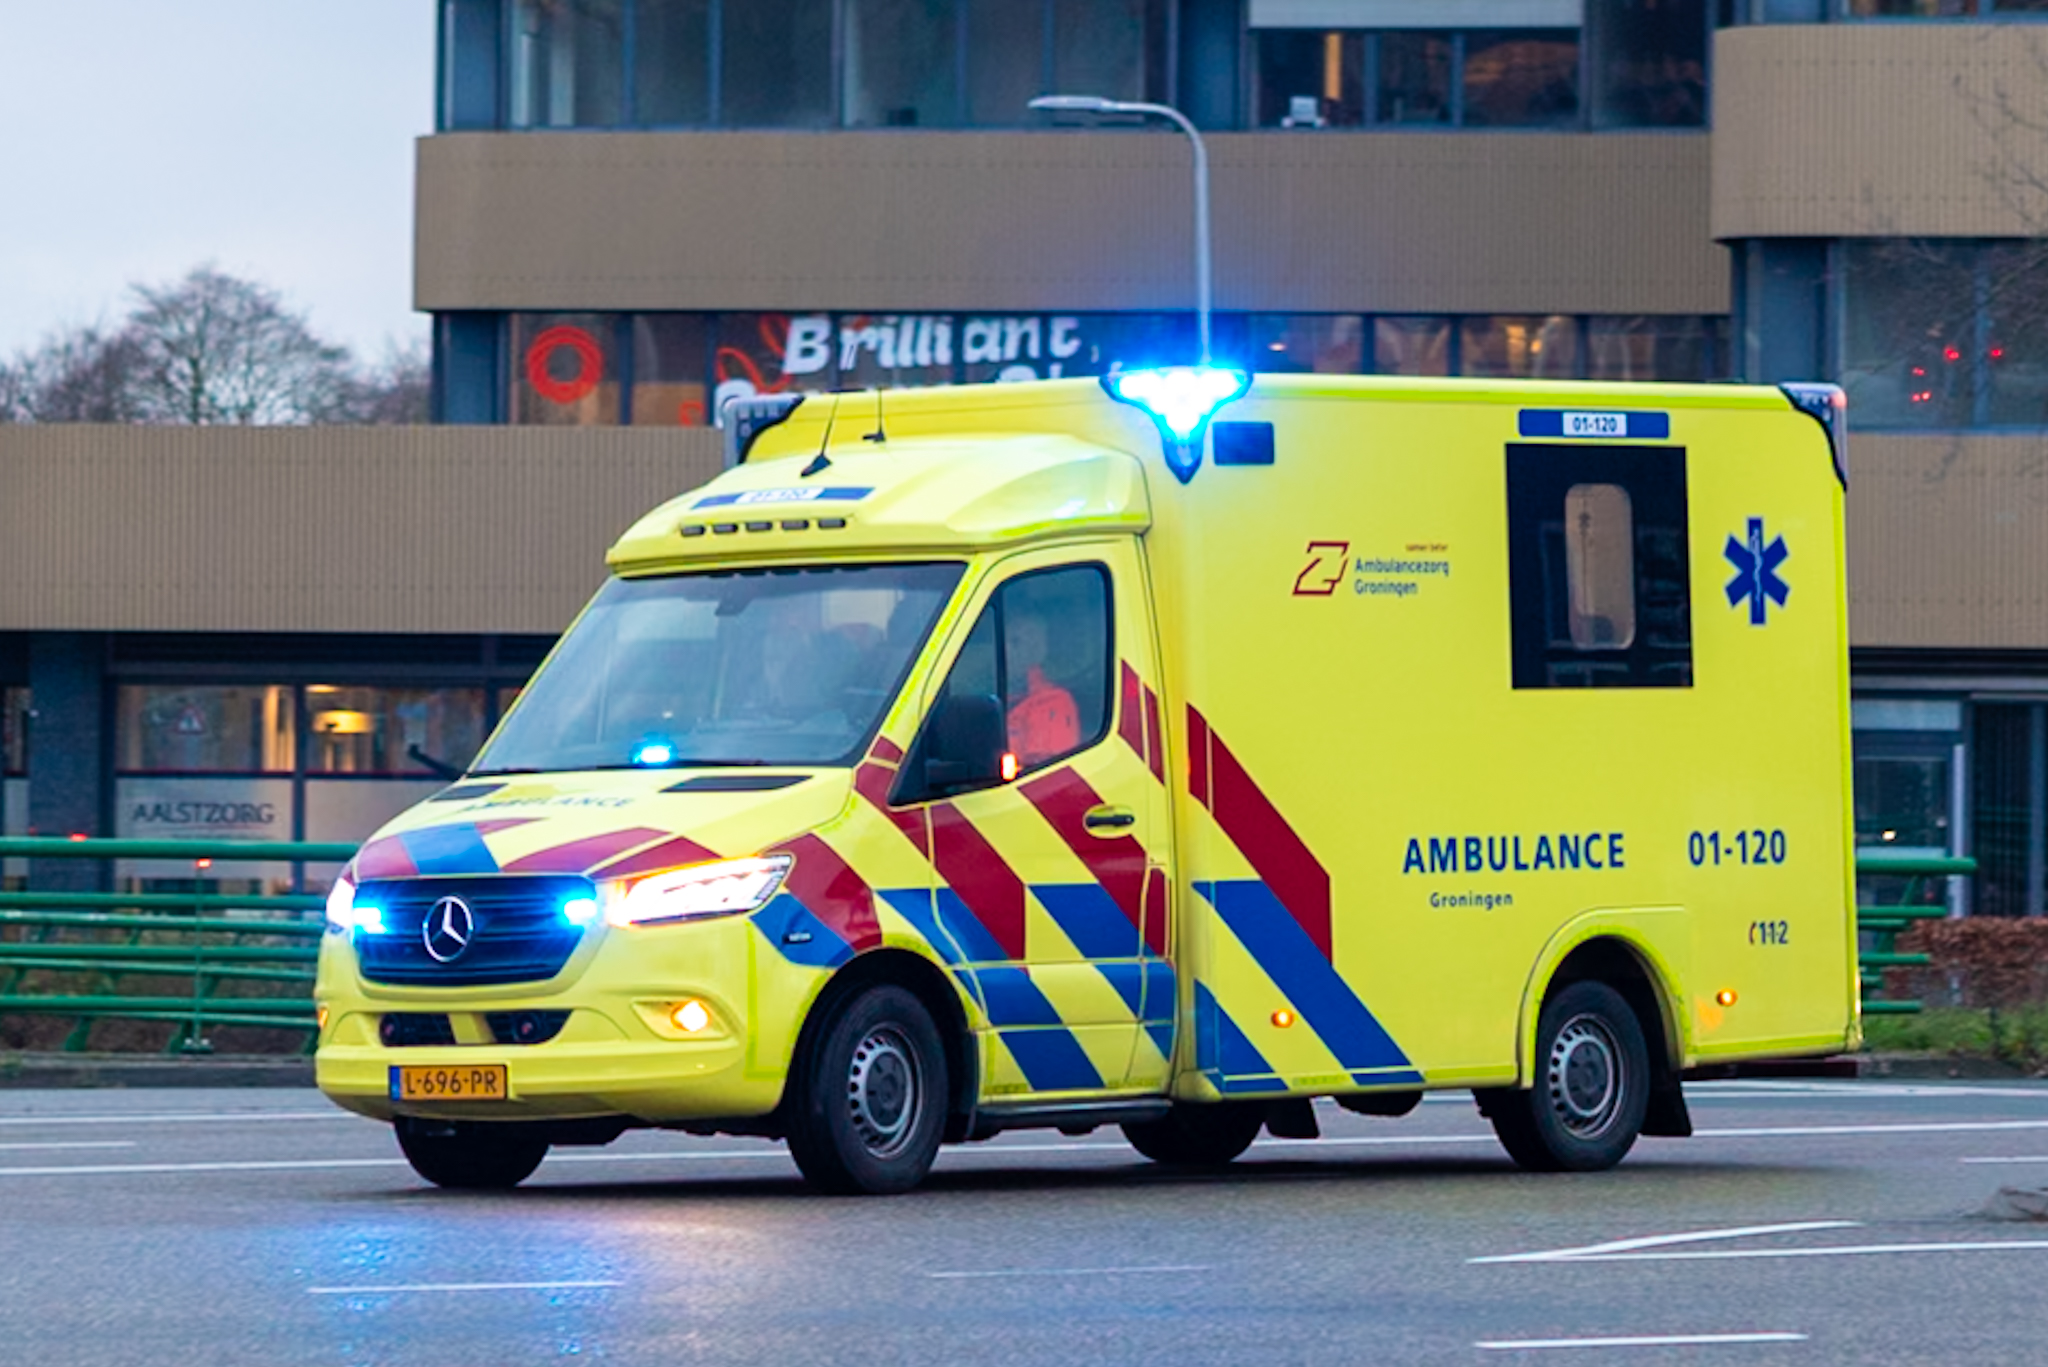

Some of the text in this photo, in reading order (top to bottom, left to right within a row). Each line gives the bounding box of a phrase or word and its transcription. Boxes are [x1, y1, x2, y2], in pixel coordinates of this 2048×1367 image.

[1573, 417, 1616, 432] 01-120
[1355, 558, 1449, 577] Ambulancezorg
[1355, 579, 1418, 598] Groningen
[133, 802, 275, 824] AALSTZORG
[1403, 833, 1624, 873] AMBULANCE
[1688, 829, 1787, 866] 01-120
[1429, 891, 1513, 911] Groningen
[406, 1069, 498, 1095] L-696-PR
